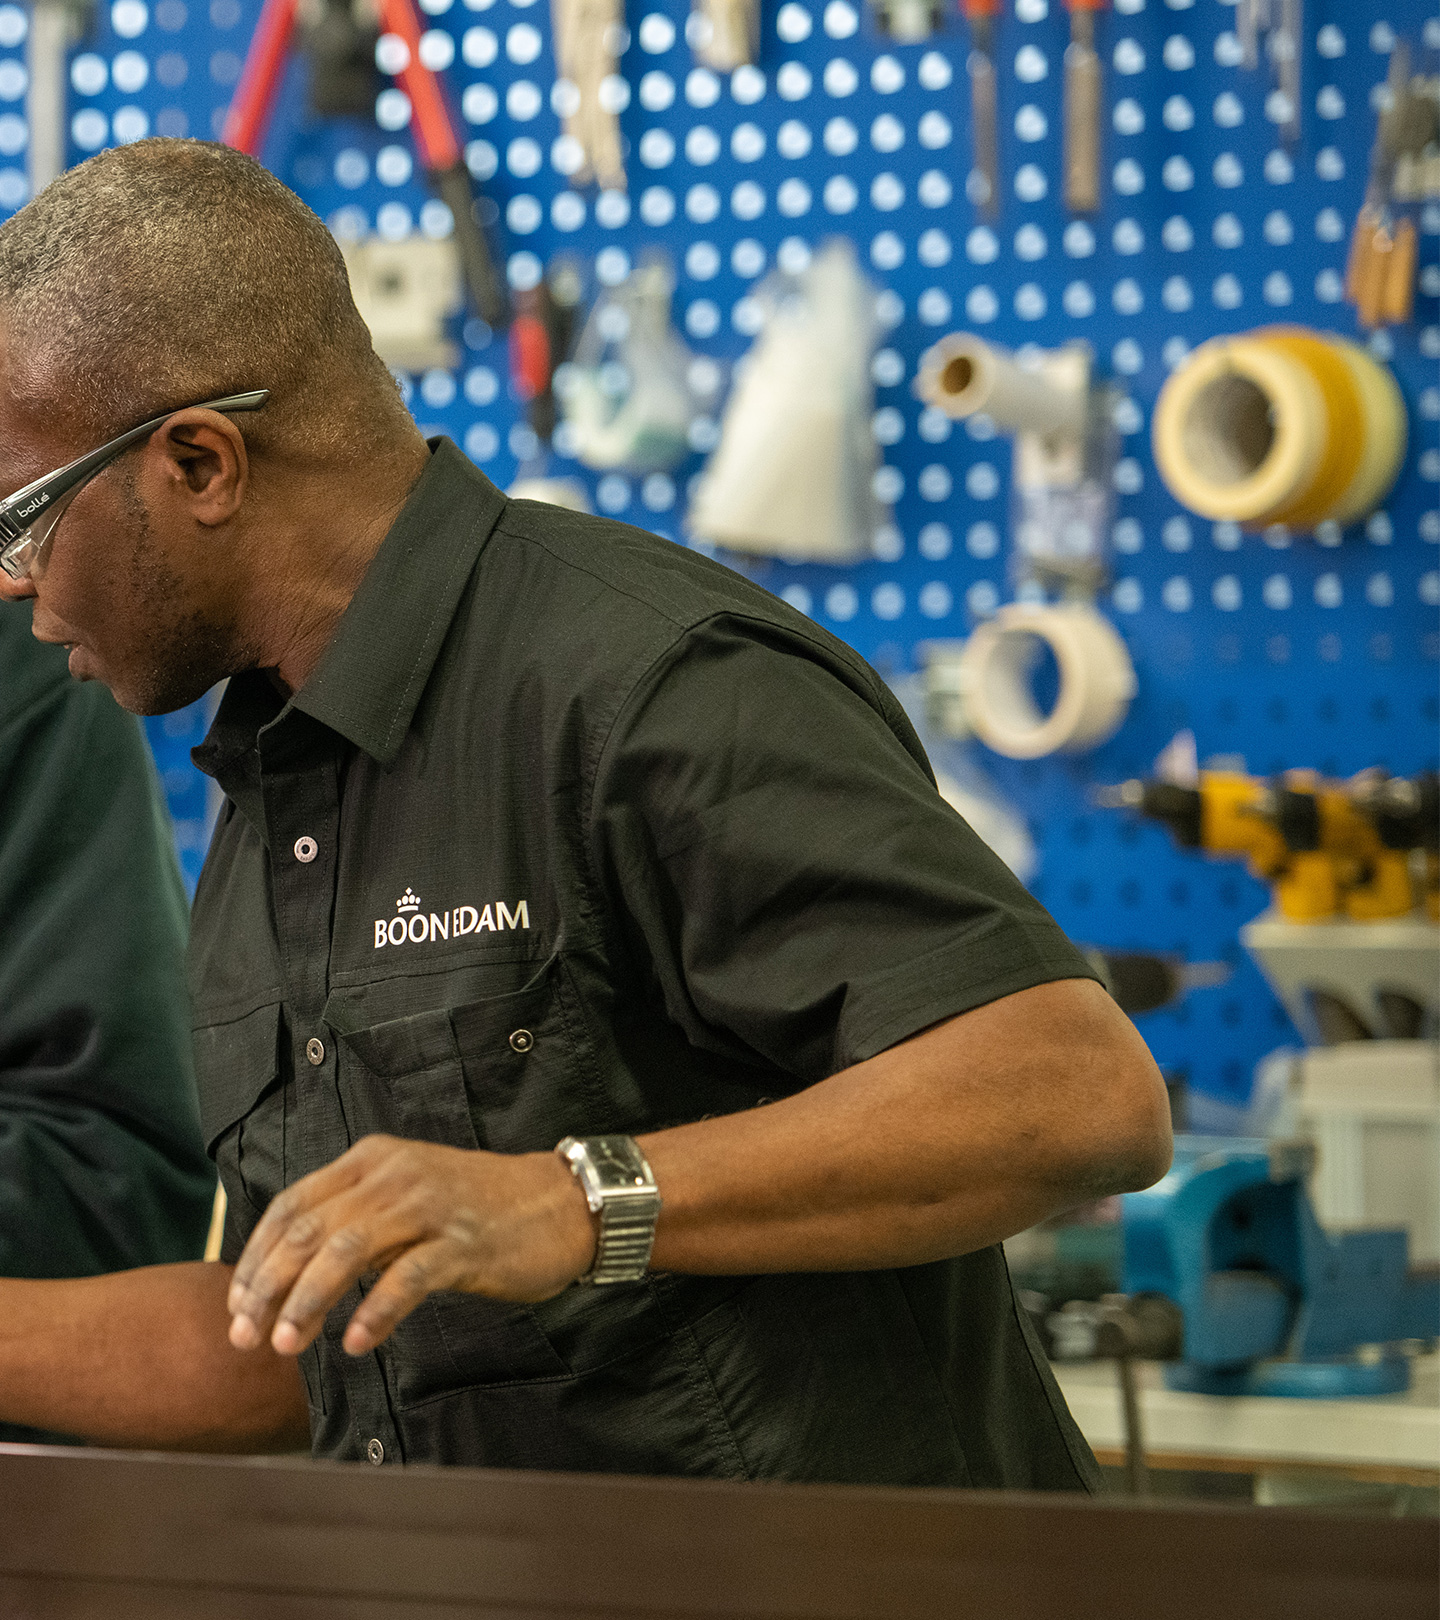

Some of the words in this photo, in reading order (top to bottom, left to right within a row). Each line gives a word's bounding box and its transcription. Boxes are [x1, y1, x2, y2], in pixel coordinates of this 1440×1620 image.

[16, 491, 50, 518] bollé
[374, 912, 450, 949] BOON
[452, 900, 530, 938] EDAM
